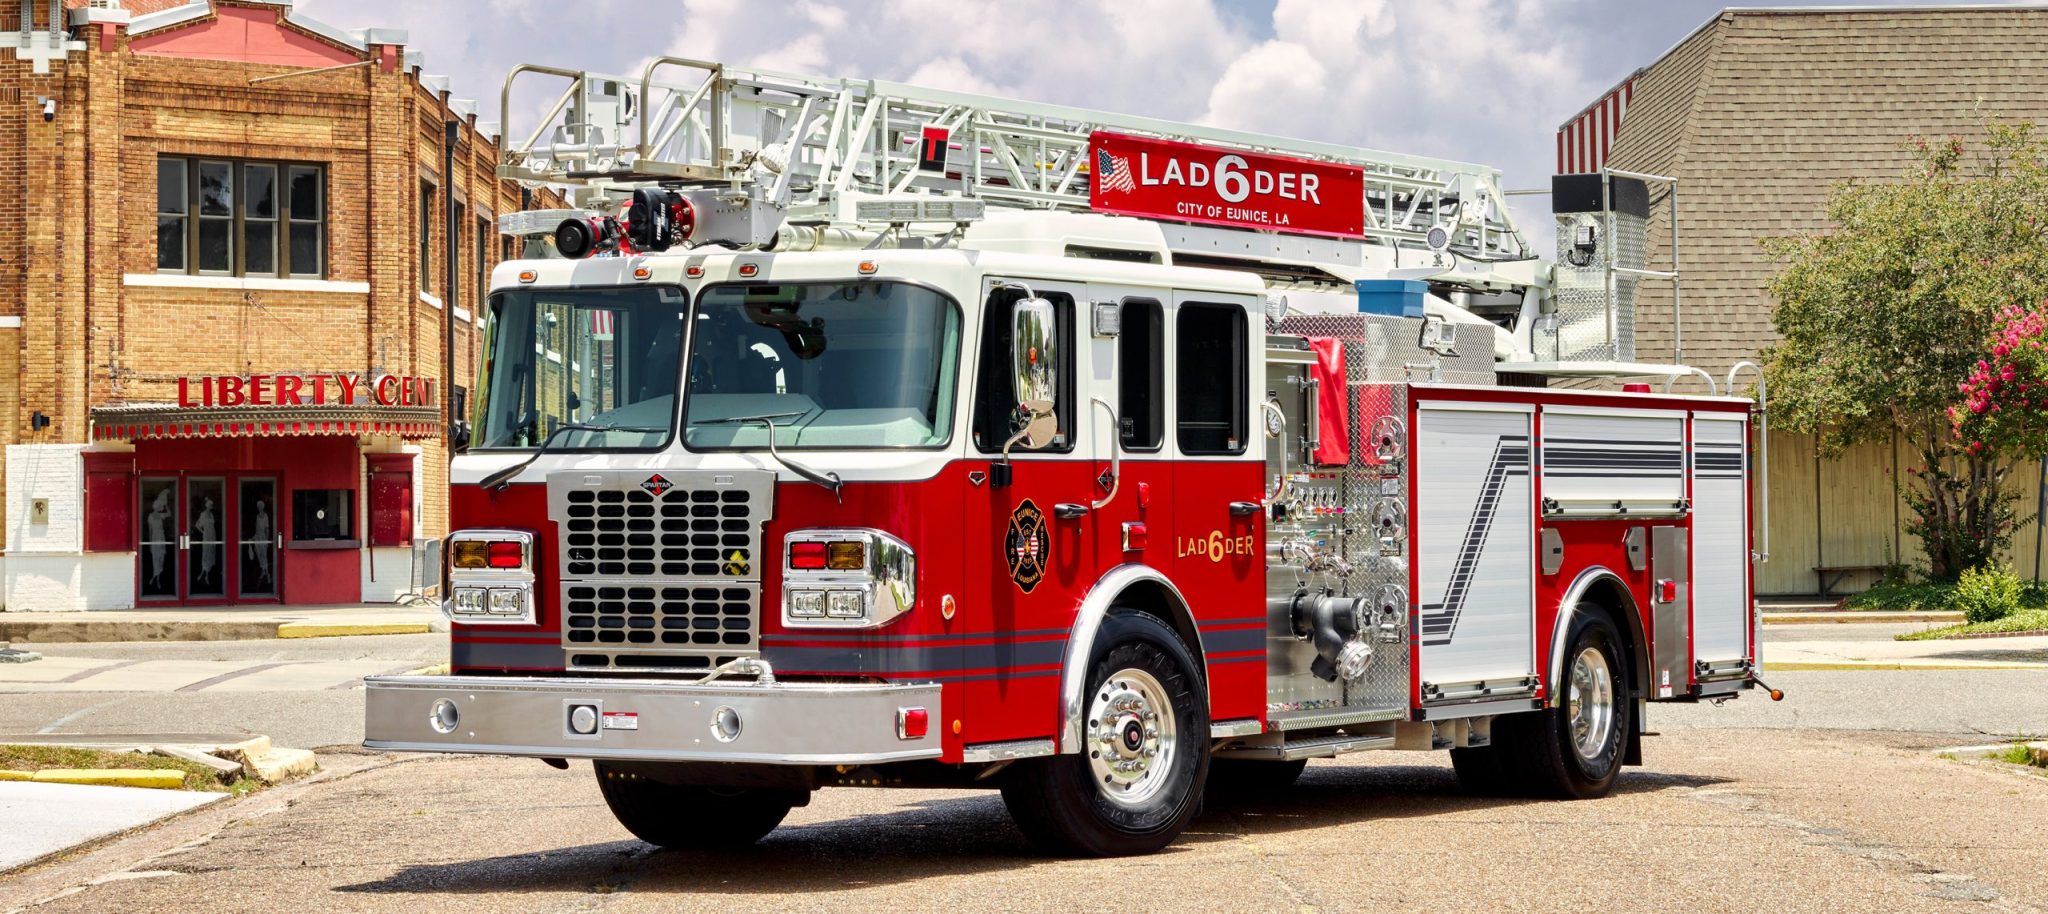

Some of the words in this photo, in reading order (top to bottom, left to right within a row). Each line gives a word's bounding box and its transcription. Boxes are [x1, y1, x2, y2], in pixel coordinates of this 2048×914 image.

[1177, 201, 1203, 215] CITY
[1207, 206, 1222, 218] OF
[1226, 207, 1272, 225] EUNICE,
[1275, 212, 1290, 225] LA
[178, 374, 360, 407] LIBERTY
[1018, 508, 1039, 521] EUNICE
[1018, 572, 1039, 583] LOUISIANA
